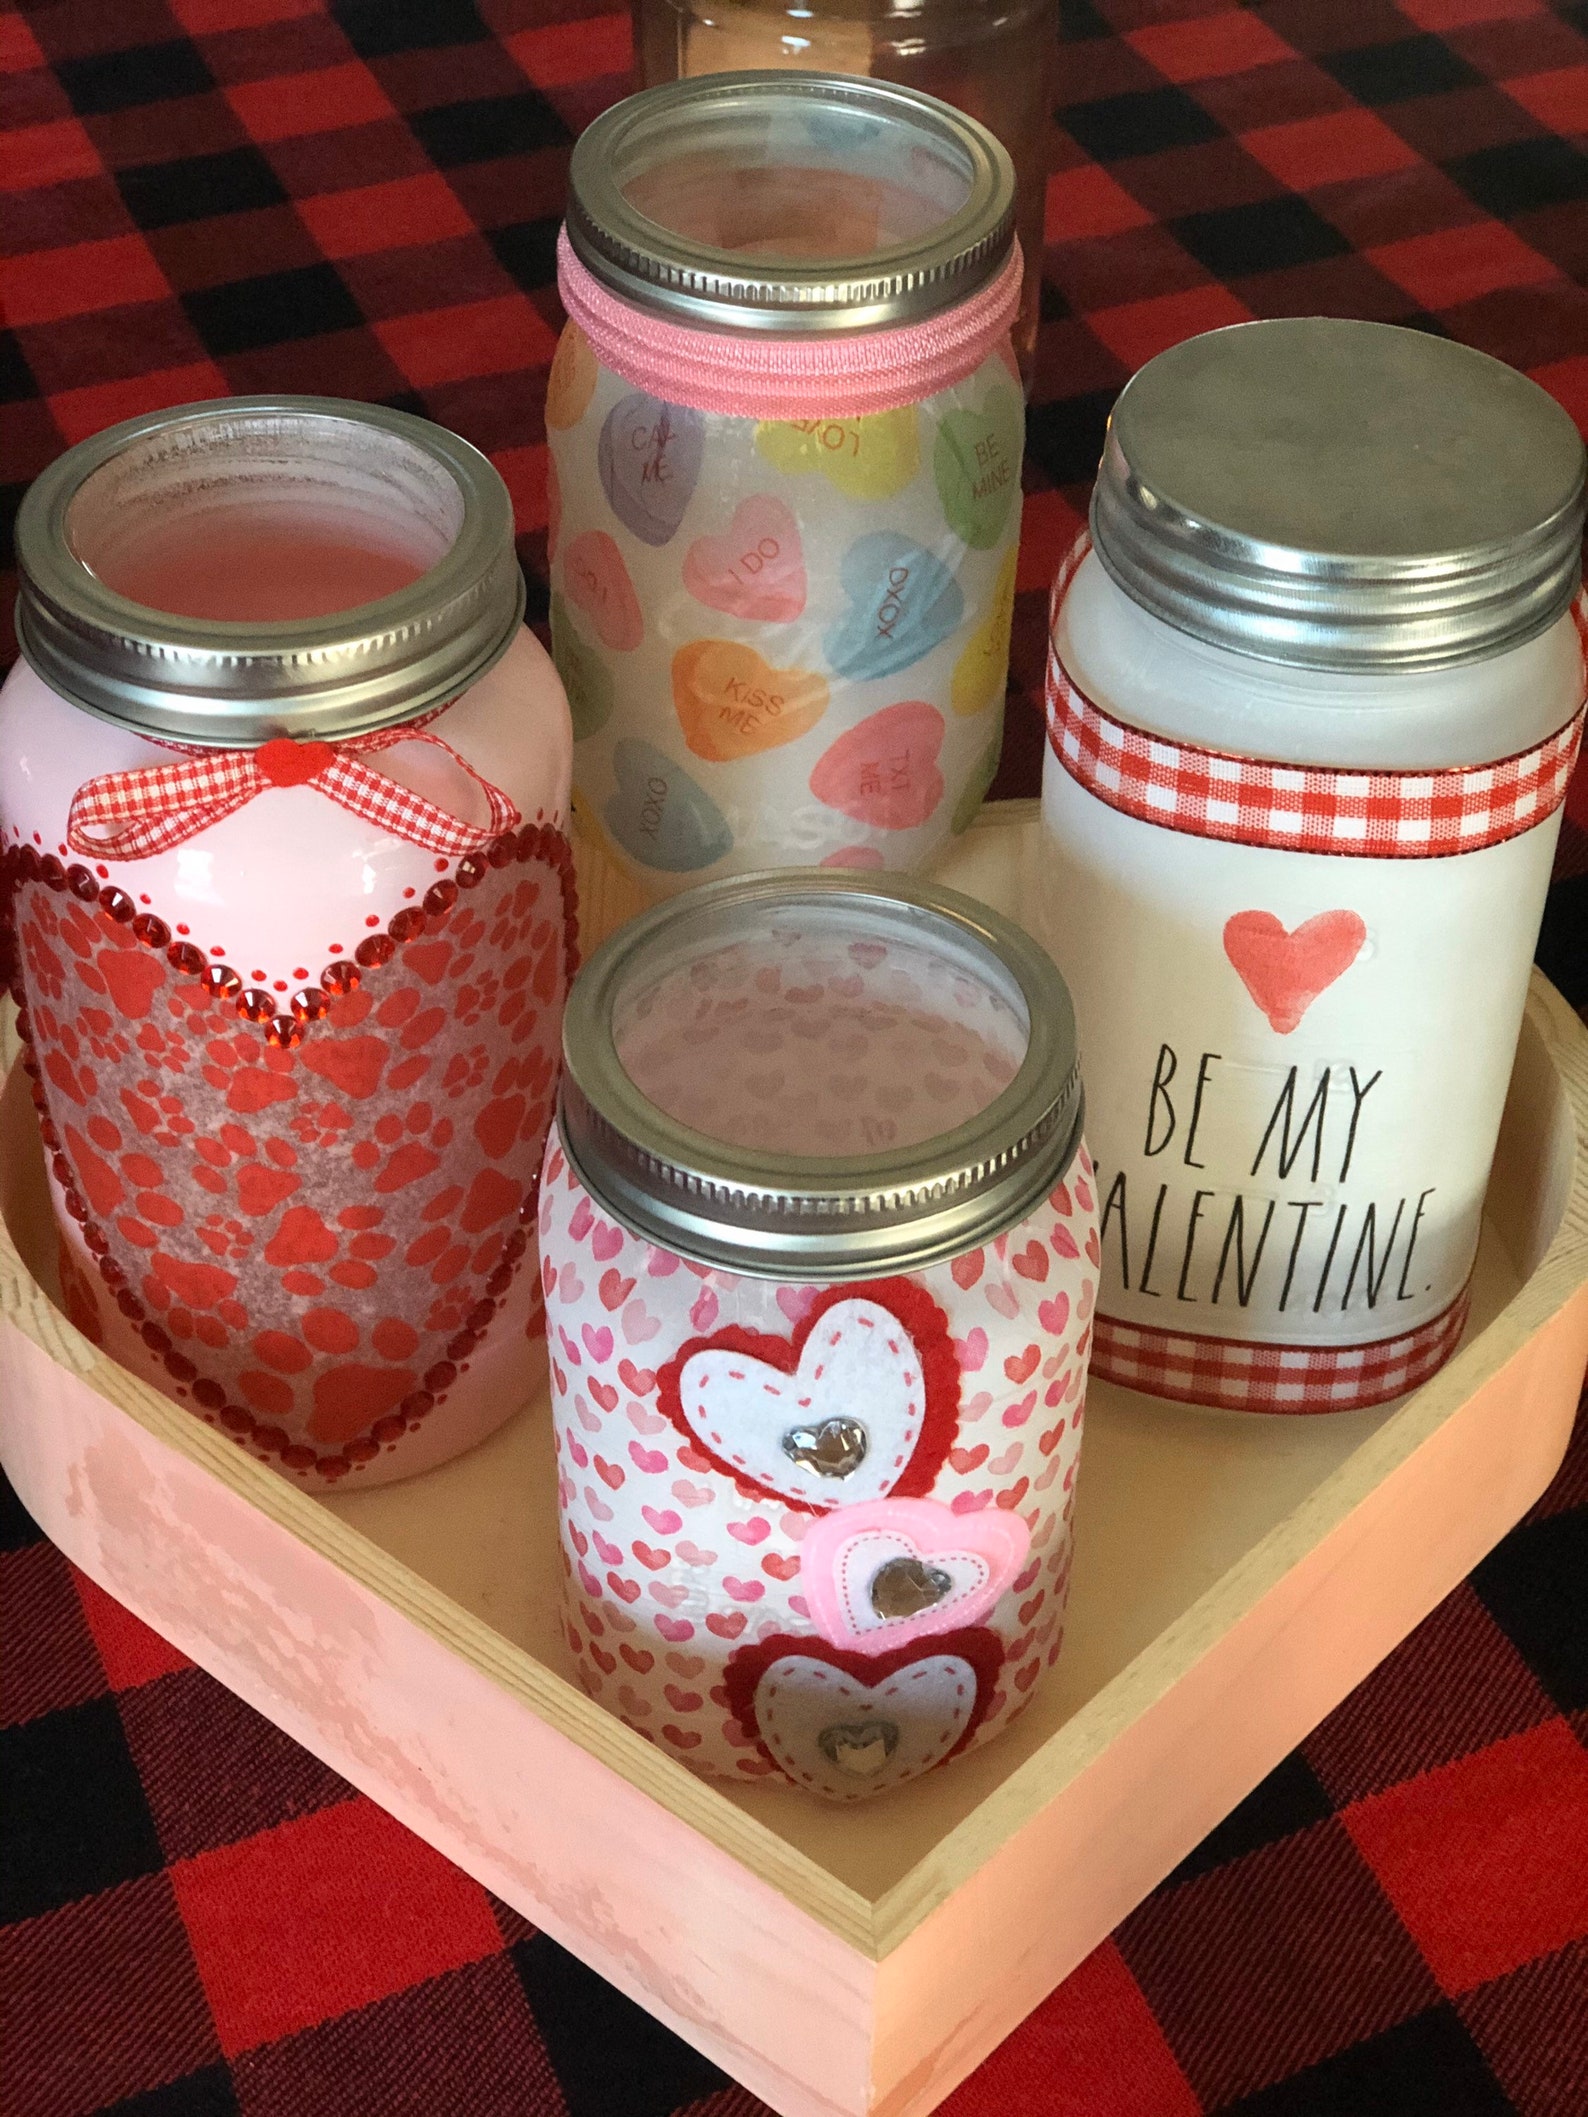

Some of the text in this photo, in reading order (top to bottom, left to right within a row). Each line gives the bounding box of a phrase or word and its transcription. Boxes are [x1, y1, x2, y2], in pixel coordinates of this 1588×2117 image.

[975, 432, 999, 467] BE
[972, 459, 1011, 500] MINE
[727, 536, 781, 586] I DO
[724, 676, 786, 721] KISS
[718, 707, 762, 736] ME
[859, 761, 882, 797] ME
[888, 748, 912, 791] TXT
[1143, 1042, 1384, 1184] BE MY
[1093, 1160, 1437, 1314] ALENTINE.
